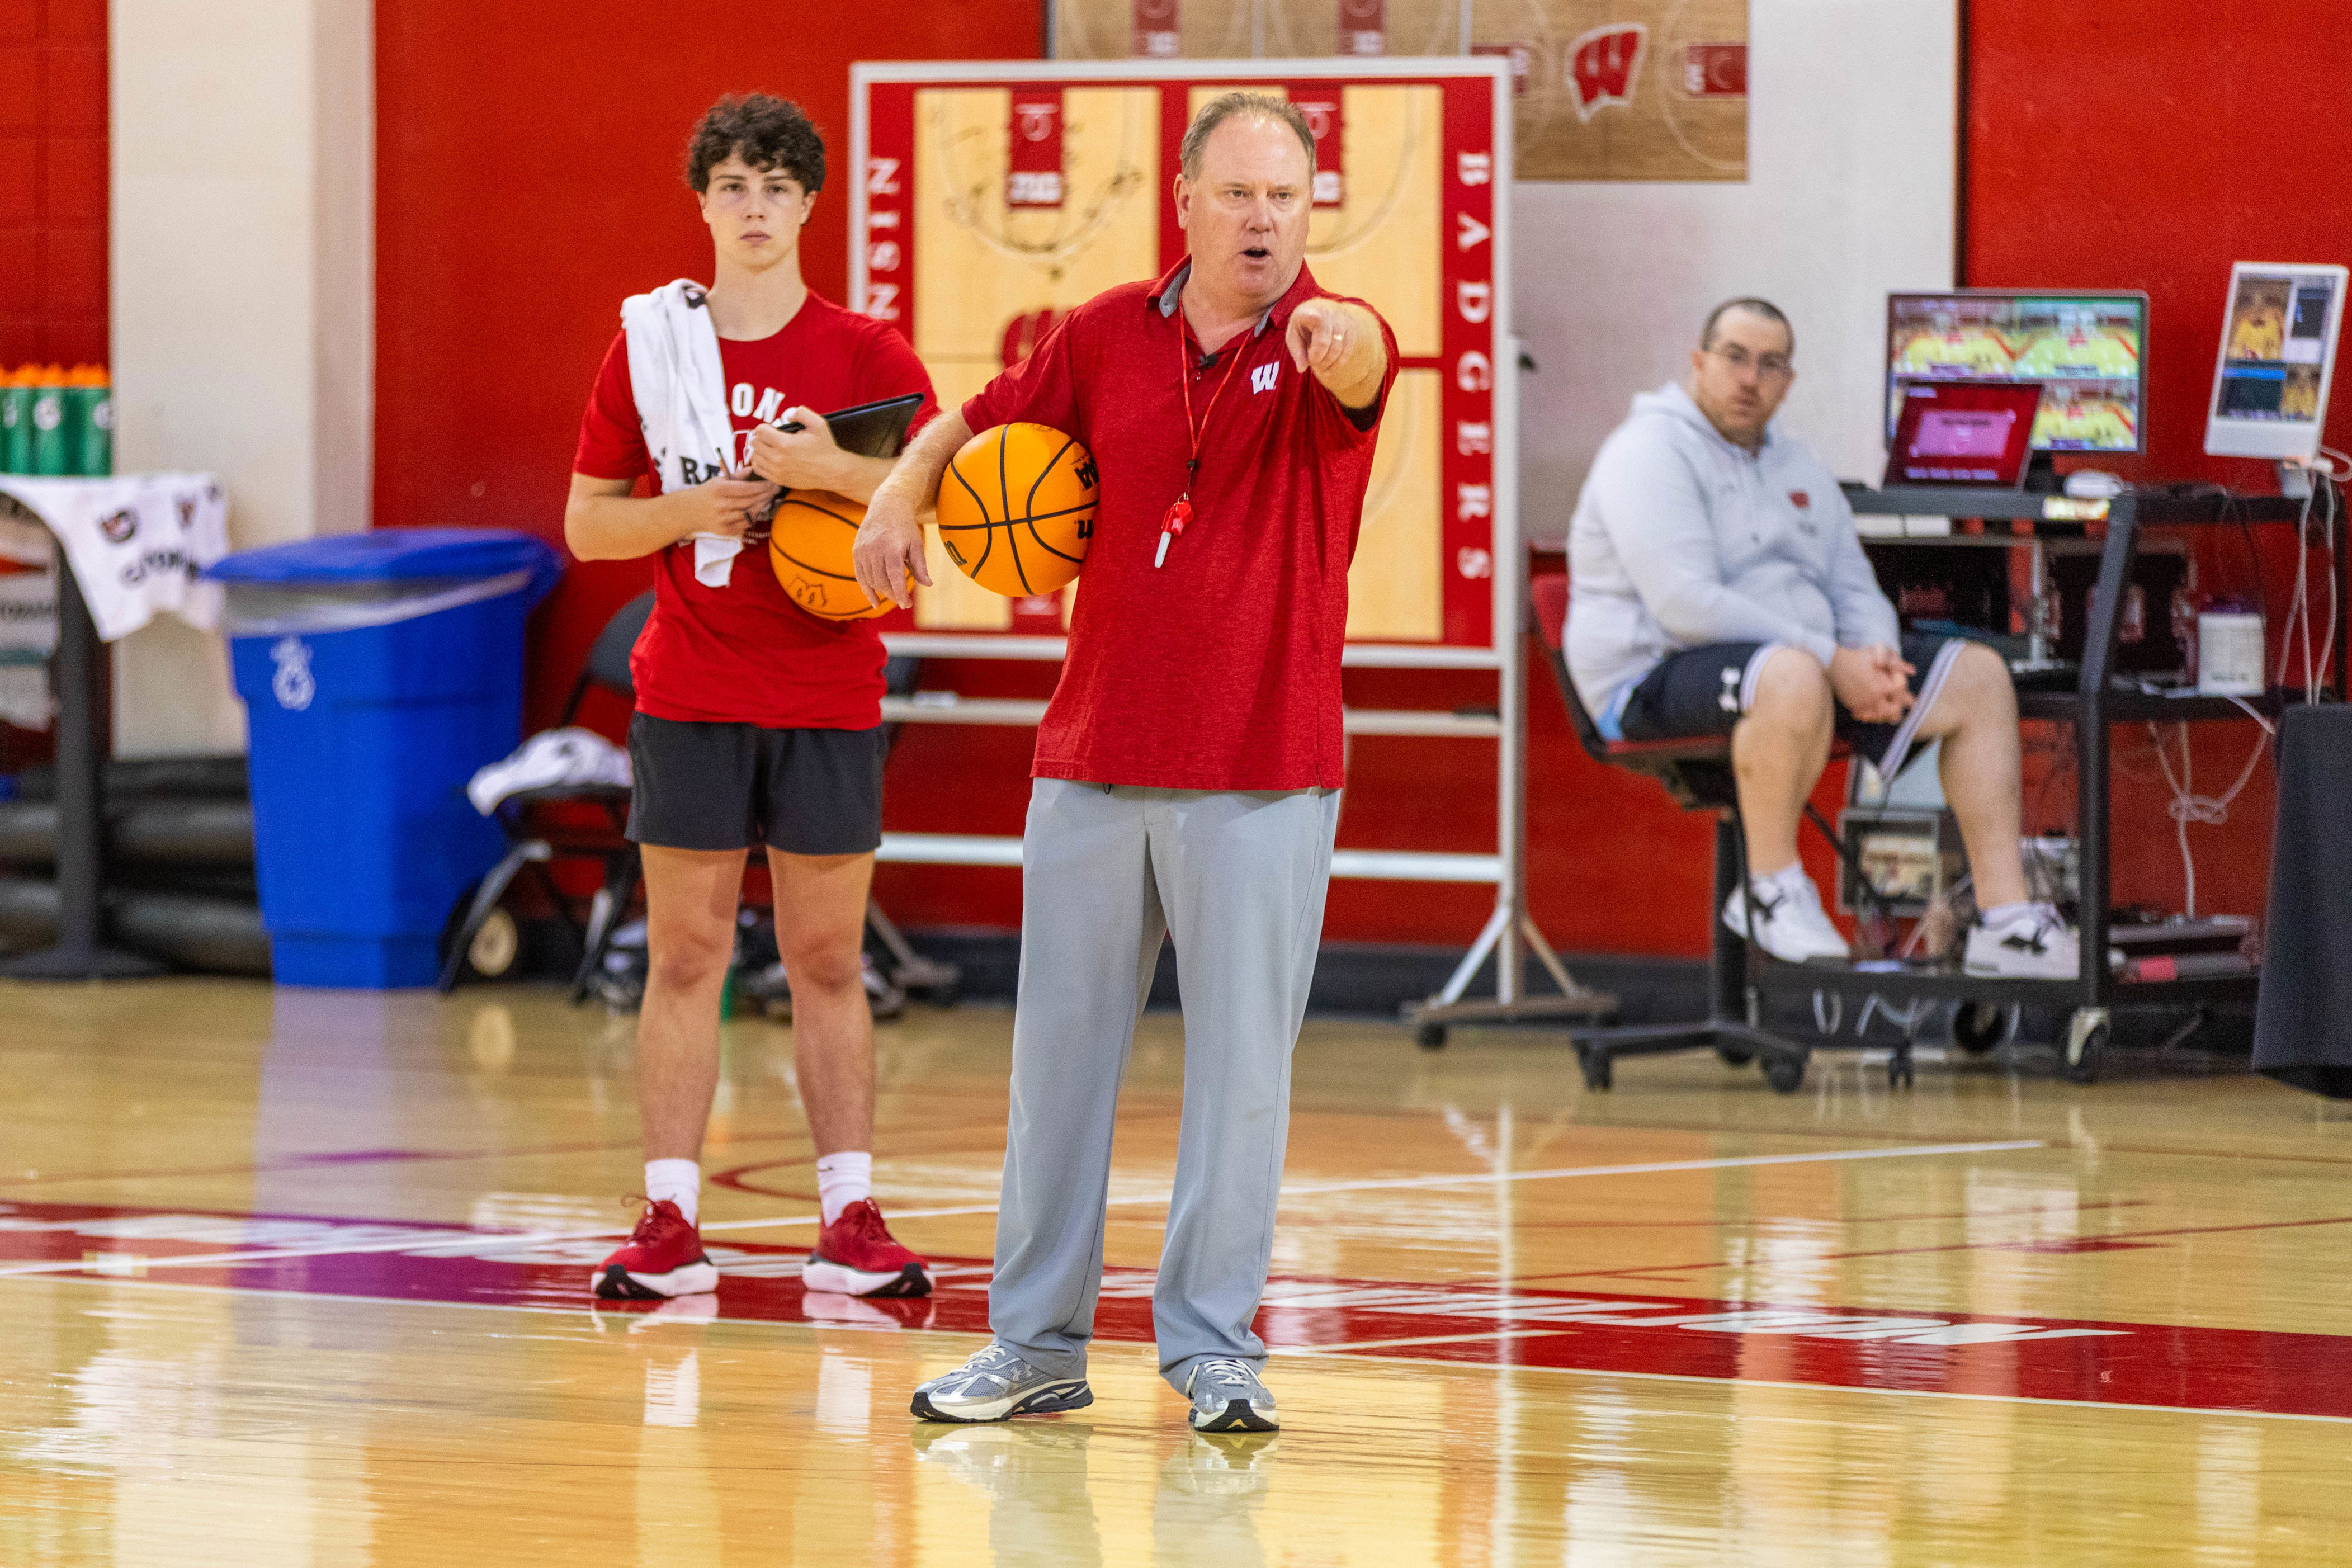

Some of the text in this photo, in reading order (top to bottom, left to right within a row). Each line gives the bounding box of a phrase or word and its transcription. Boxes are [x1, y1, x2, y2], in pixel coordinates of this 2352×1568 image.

[867, 158, 900, 320] NSIN
[1250, 361, 1279, 395] W
[1457, 153, 1490, 579] BADGERS
